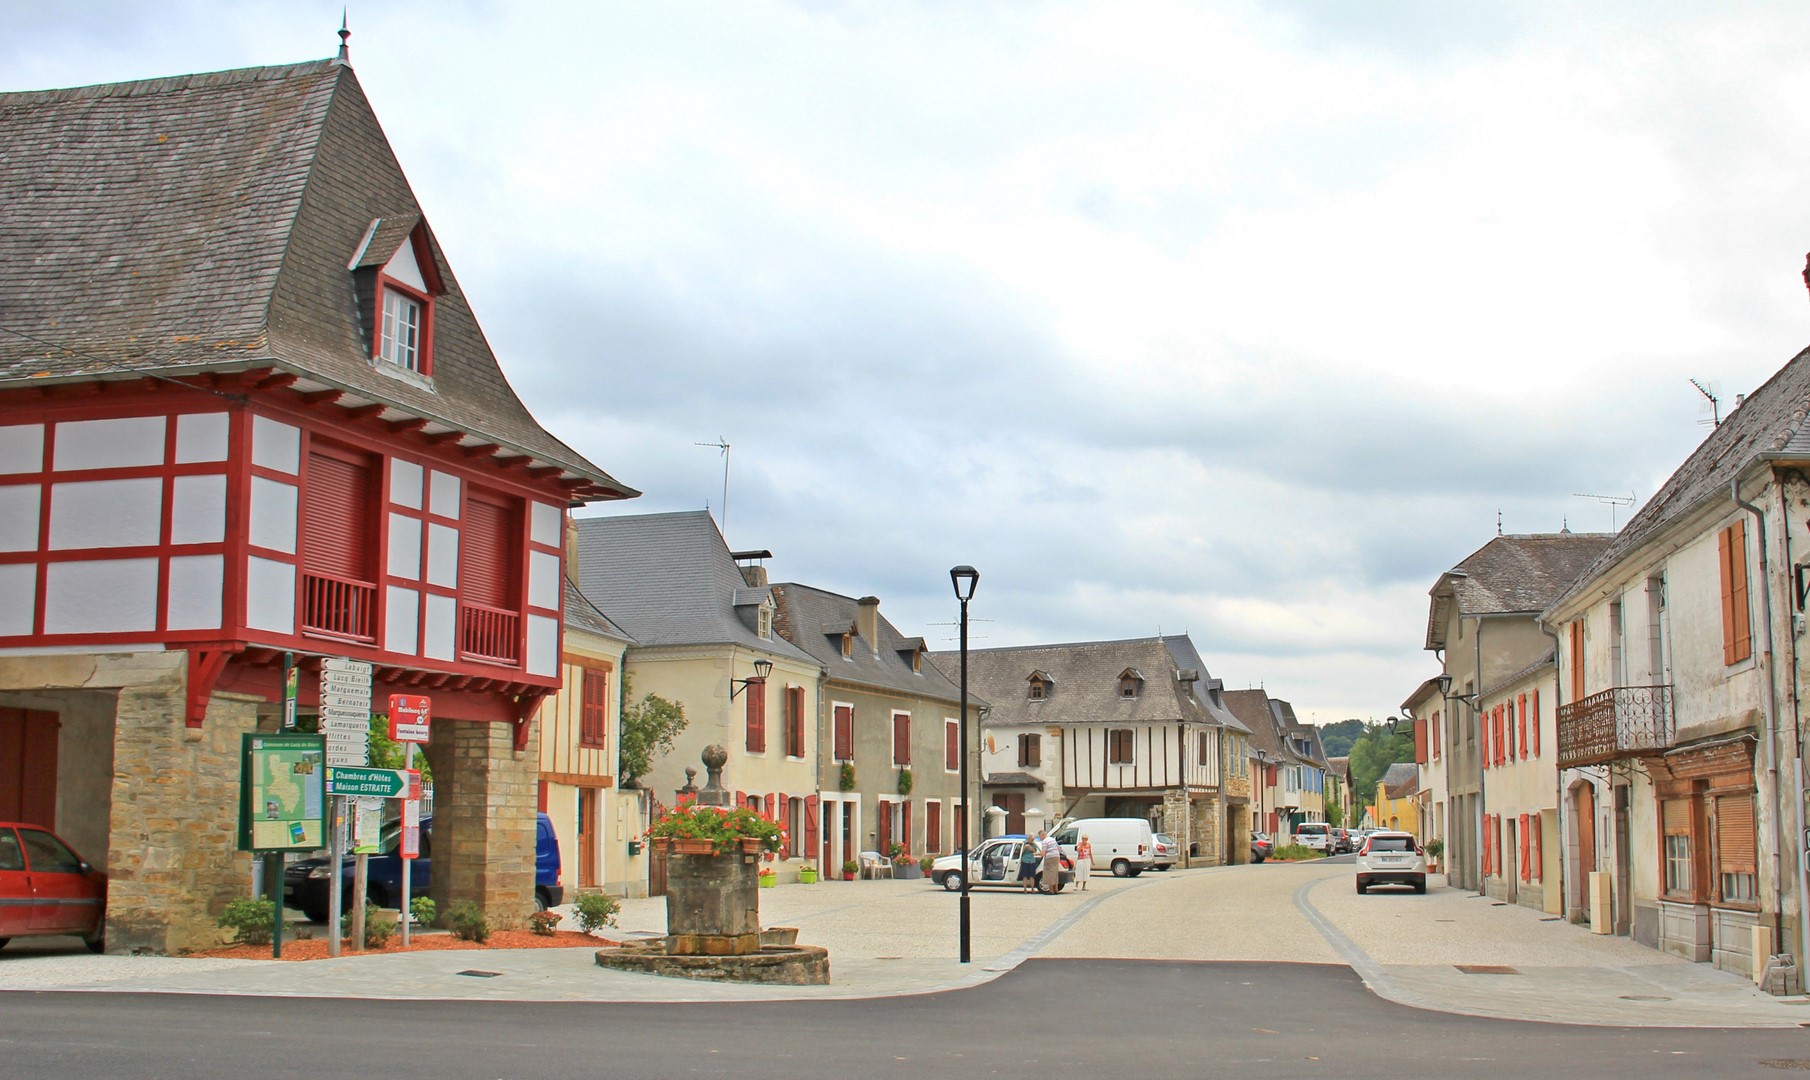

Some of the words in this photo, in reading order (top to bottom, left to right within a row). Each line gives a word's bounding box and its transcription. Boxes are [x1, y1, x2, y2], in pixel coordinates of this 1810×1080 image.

[345, 663, 370, 673] Labaigt
[333, 673, 348, 682] Lucq
[328, 744, 347, 752] ordes
[328, 757, 348, 765] egues
[336, 771, 367, 781] Chambres
[368, 773, 392, 783] d'Hôtes
[336, 782, 359, 791] Maison
[360, 783, 392, 793] ESTRATTE
